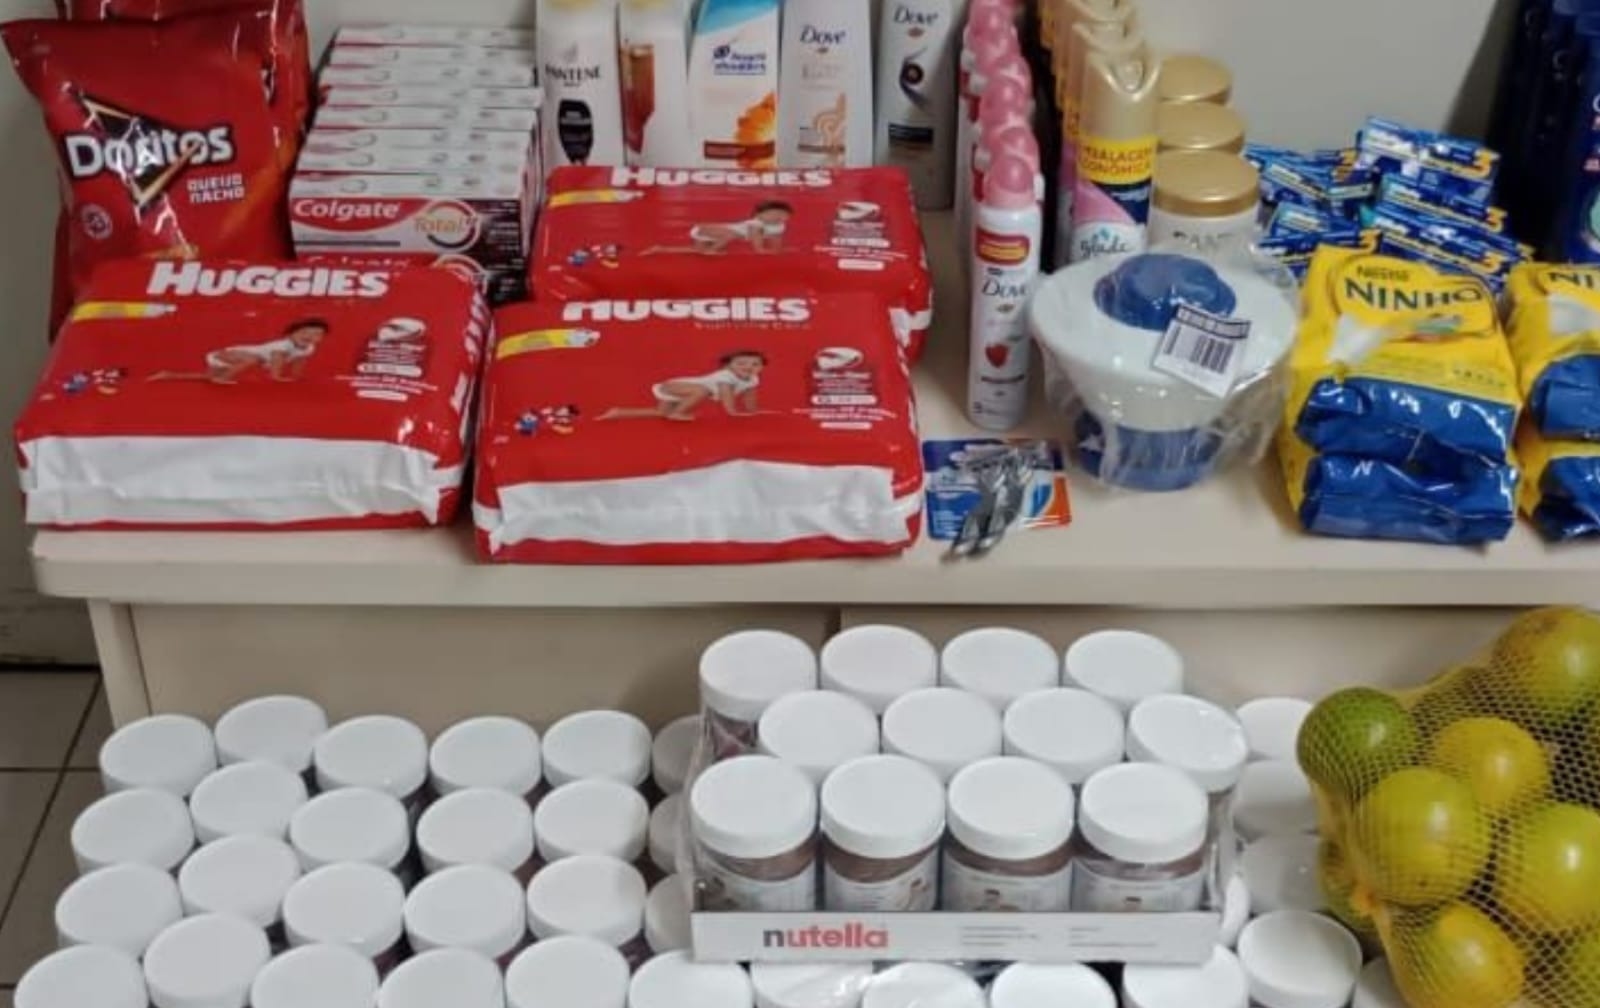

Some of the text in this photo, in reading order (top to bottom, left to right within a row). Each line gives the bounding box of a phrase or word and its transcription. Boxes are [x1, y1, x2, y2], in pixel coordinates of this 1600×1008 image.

[894, 5, 939, 25] Dove
[799, 24, 847, 44] Dove
[65, 126, 234, 178] Doritos
[611, 166, 833, 188] HUGGIES
[294, 199, 400, 222] Colgate
[145, 260, 391, 297] HUGGIES
[981, 278, 1027, 297] Dove
[1345, 277, 1483, 311] NINHO
[562, 297, 812, 321] HUGGIES
[762, 922, 889, 949] nutella
